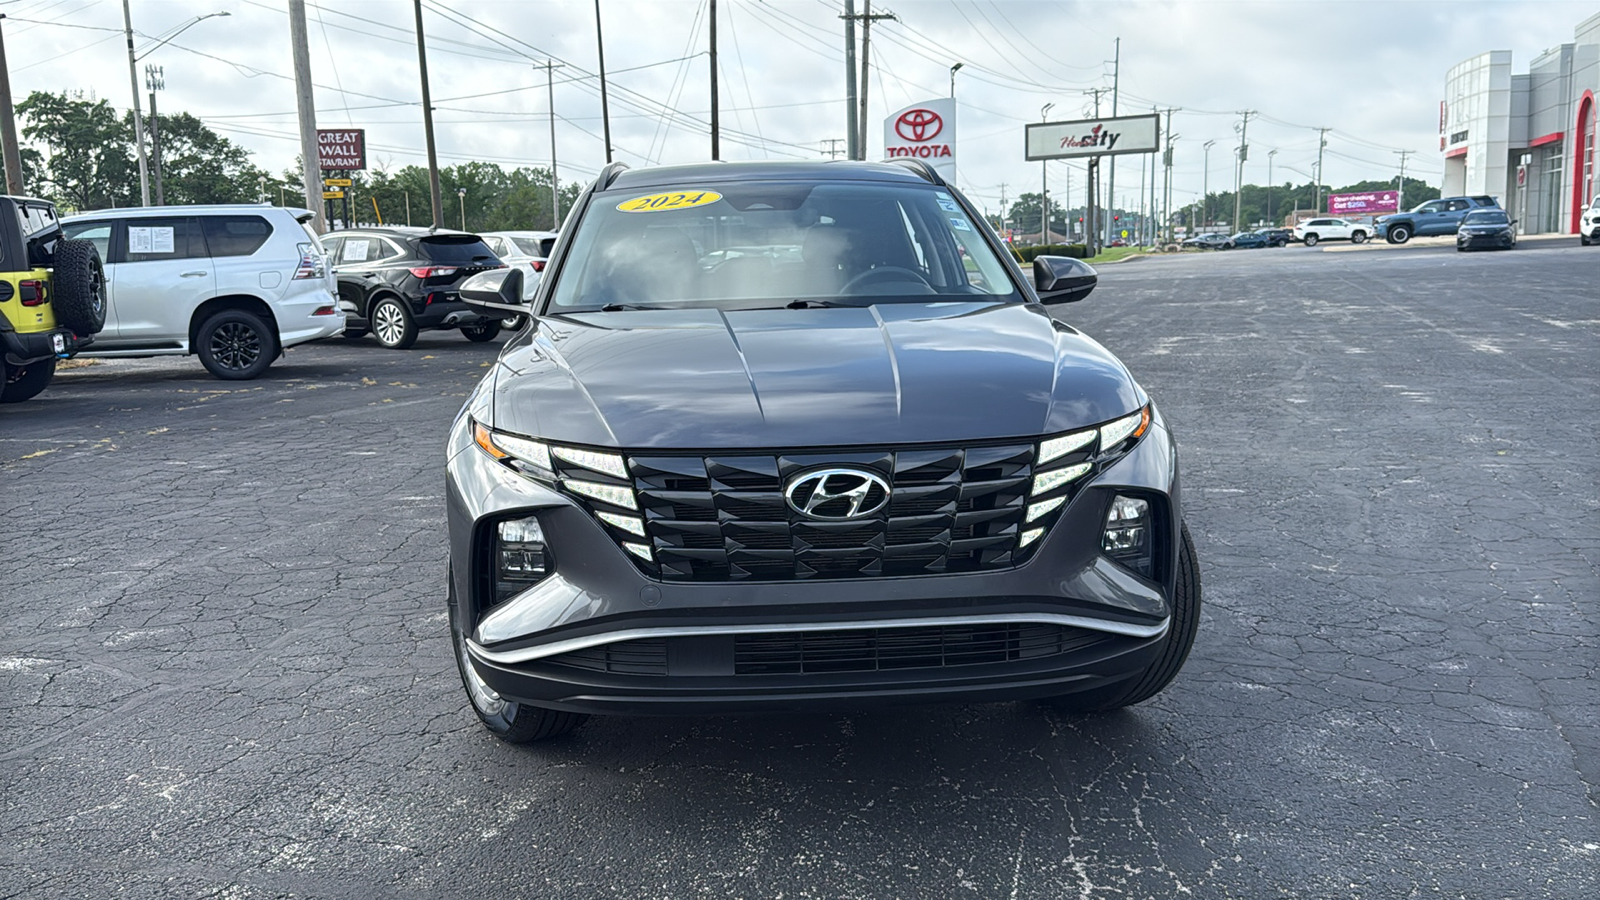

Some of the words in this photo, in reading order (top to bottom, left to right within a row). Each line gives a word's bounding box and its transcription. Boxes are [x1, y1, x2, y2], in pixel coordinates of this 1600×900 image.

[318, 132, 358, 144] GREAT
[319, 145, 358, 156] WALL
[886, 144, 952, 158] TOYOTA
[319, 158, 361, 167] TAURANT
[631, 192, 707, 211] 2024
